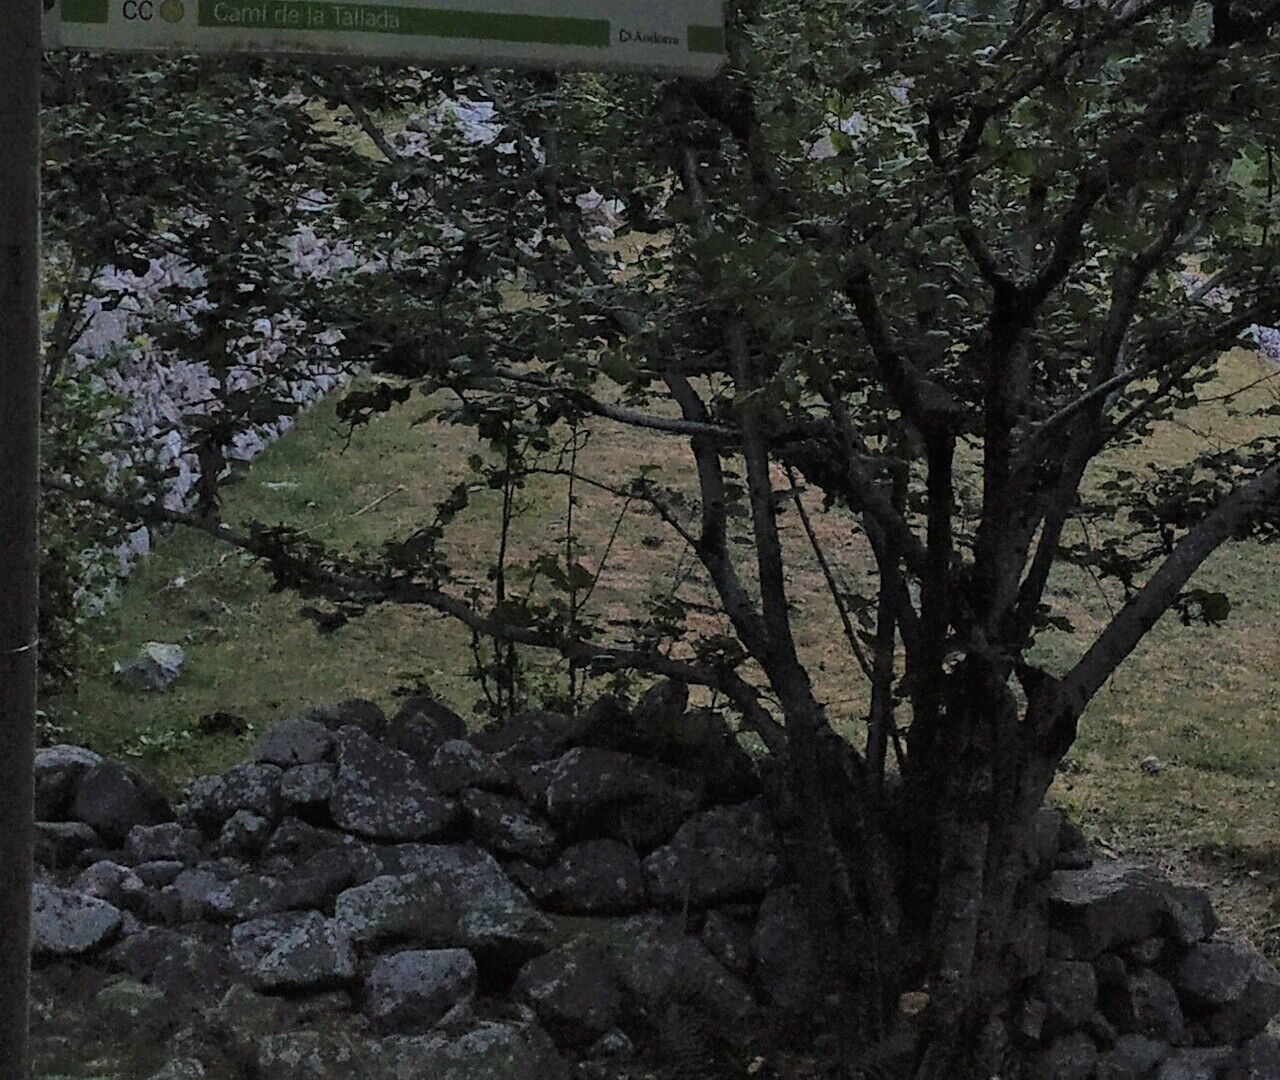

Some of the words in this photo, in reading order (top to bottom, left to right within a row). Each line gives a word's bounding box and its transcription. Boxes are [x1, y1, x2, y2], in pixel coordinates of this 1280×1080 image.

[122, 0, 153, 21] CC
[274, 5, 300, 24] de
[308, 8, 324, 24] la
